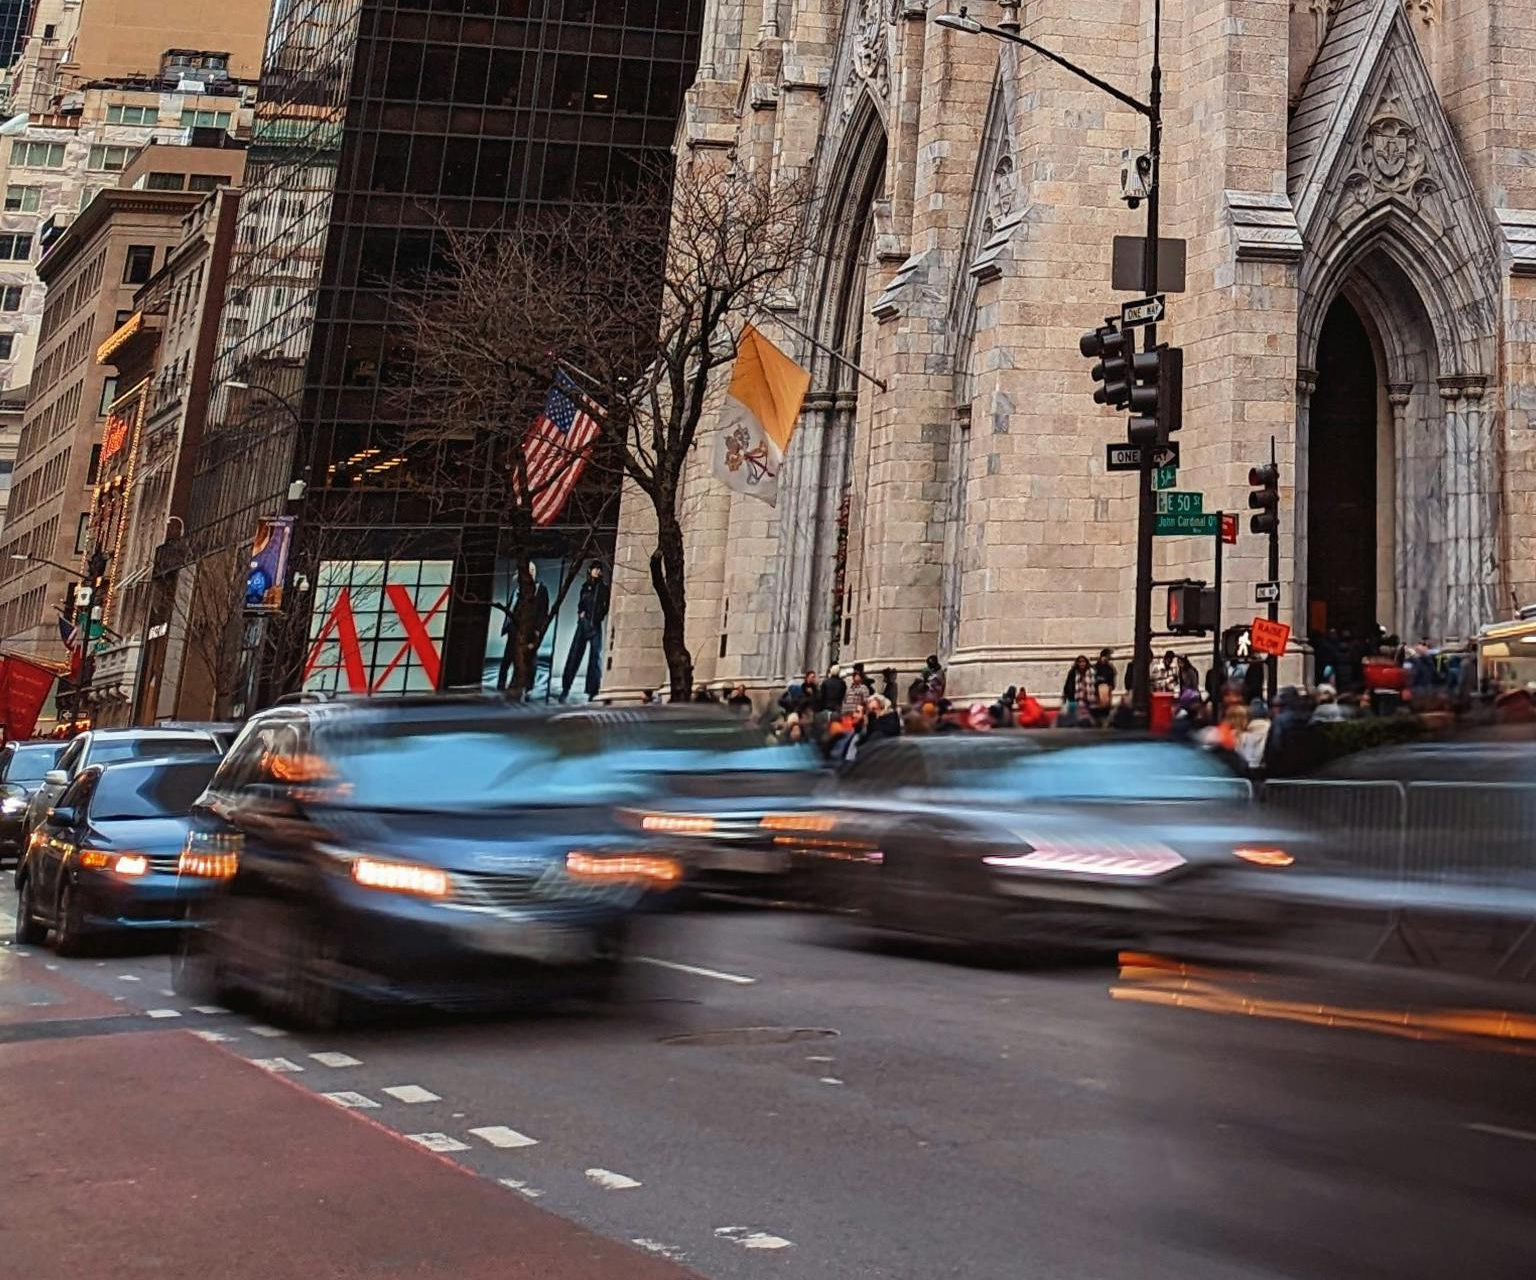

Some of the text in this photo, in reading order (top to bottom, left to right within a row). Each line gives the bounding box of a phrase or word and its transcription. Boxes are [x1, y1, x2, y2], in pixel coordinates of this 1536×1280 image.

[1127, 304, 1160, 320] ONE WAY
[1117, 451, 1139, 462] ONE
[1168, 494, 1174, 511] E
[1177, 494, 1190, 511] 50
[1158, 515, 1176, 527] John
[1177, 515, 1206, 527] Cardinal
